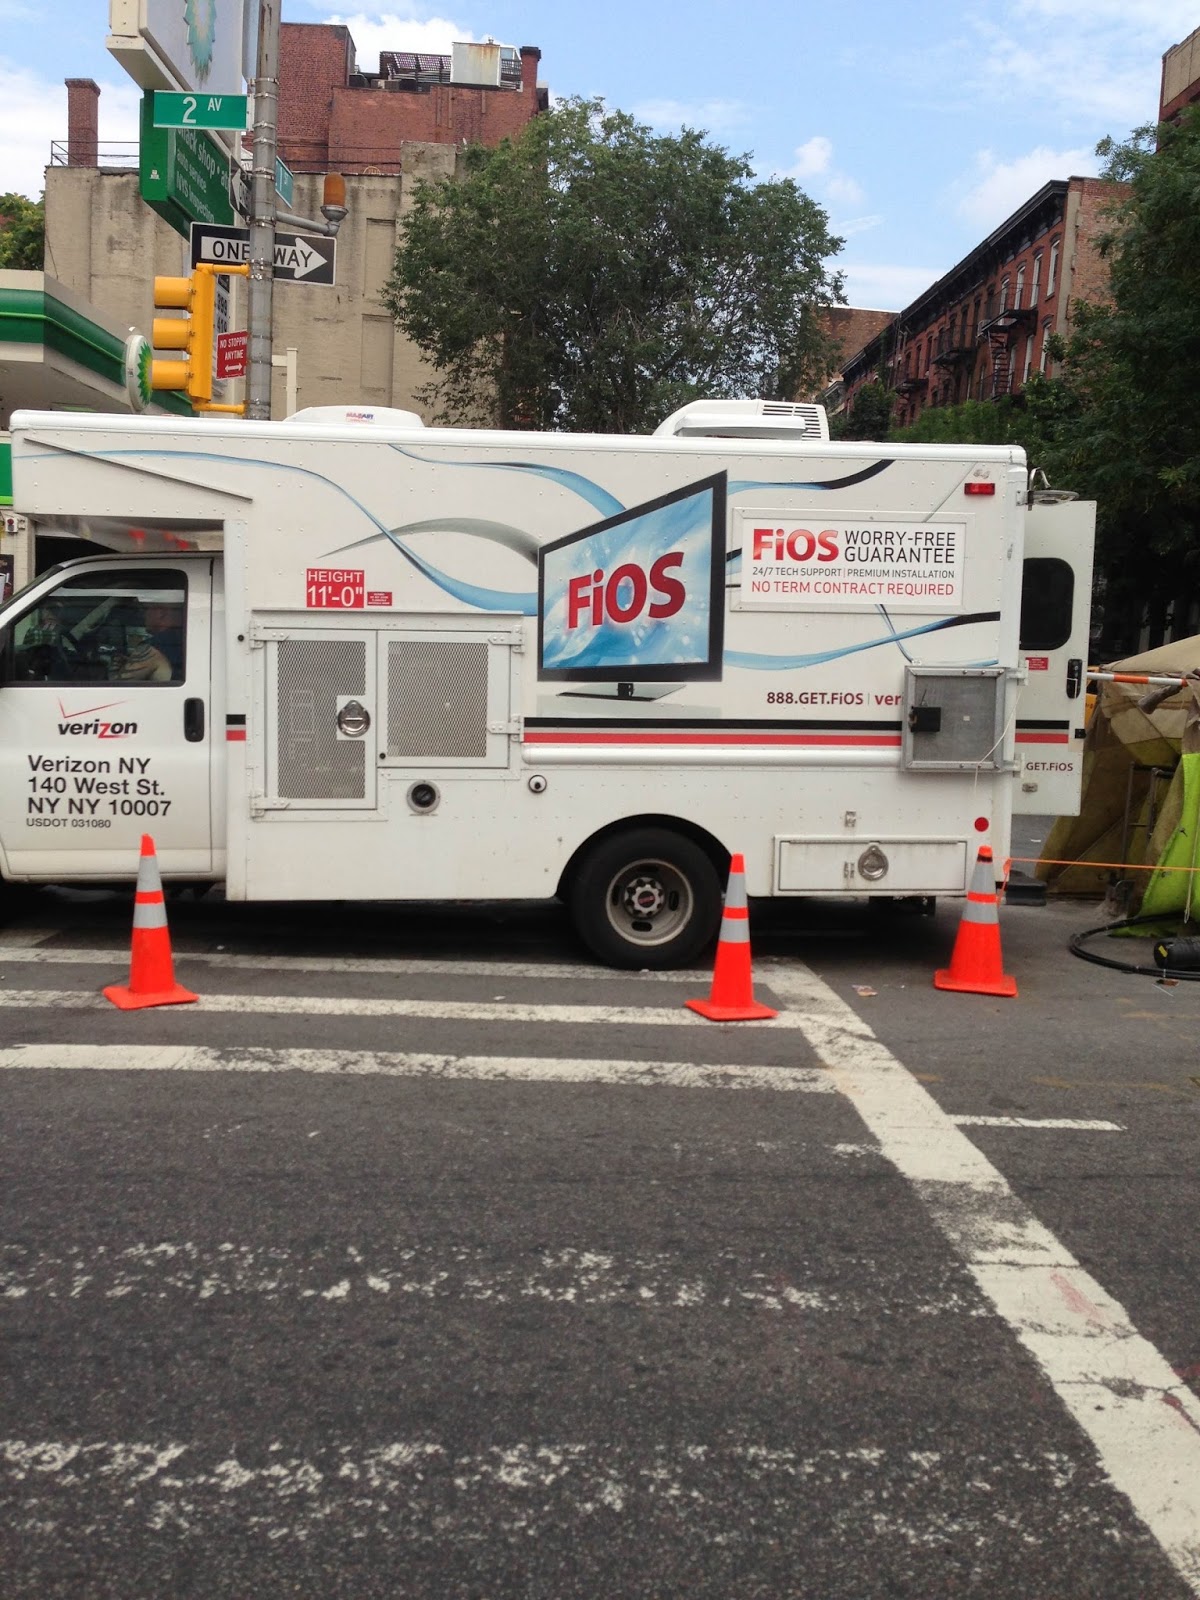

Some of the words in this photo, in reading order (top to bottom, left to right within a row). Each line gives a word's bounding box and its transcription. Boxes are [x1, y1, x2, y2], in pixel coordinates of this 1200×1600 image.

[182, 97, 197, 124] 2
[207, 98, 222, 111] AV
[198, 141, 216, 179] shop
[212, 240, 250, 261] ONE
[273, 247, 313, 268] WAY
[220, 340, 227, 349] NO
[228, 336, 248, 348] STOPPIN
[225, 349, 244, 361] ANYTIME
[753, 528, 840, 562] FiOS
[844, 530, 956, 547] WORRY-FREE
[844, 546, 955, 564] GUARANTEE
[308, 570, 363, 583] HEIGHT
[752, 566, 774, 576] 24/7
[776, 567, 799, 576] TECH
[800, 567, 842, 578] SUPPORT
[847, 568, 890, 578] PREMIUM
[892, 568, 955, 579] INSTALLATION
[308, 585, 363, 607] 11'-0"
[568, 551, 686, 629] FiOS
[752, 581, 771, 593] NO
[774, 581, 810, 593] TERM
[813, 582, 885, 595] CONTRACT
[887, 583, 954, 596] REQUIRED
[766, 692, 864, 705] 888.GET.FiOS
[58, 719, 138, 739] verizon
[28, 755, 111, 773] Verizon
[119, 757, 151, 774] NY
[28, 776, 67, 793] 140
[74, 777, 130, 795] West
[136, 778, 165, 796] St.
[28, 797, 61, 814] NY
[68, 798, 101, 815] NY
[108, 800, 172, 816] 10007
[26, 818, 69, 827] USDOT
[71, 819, 111, 828] 031080
